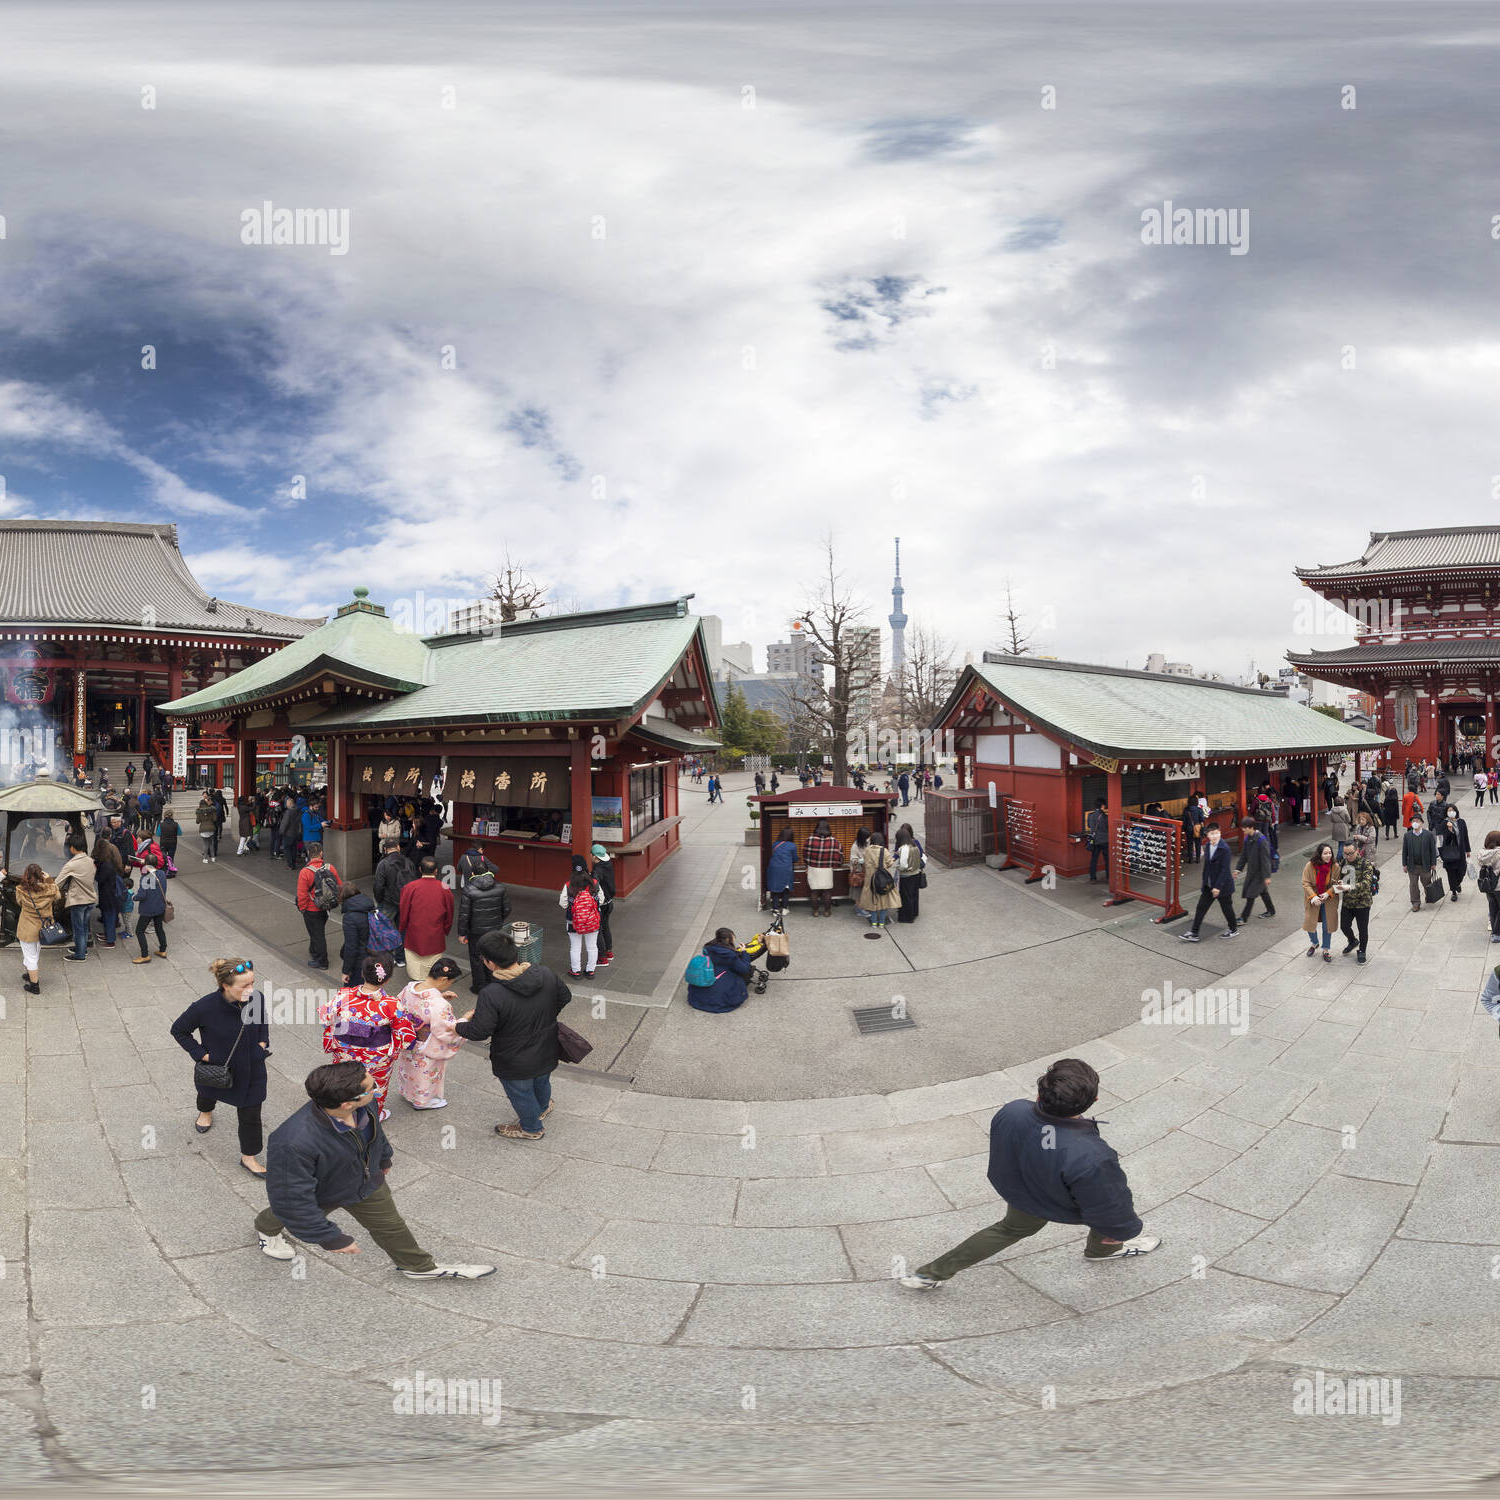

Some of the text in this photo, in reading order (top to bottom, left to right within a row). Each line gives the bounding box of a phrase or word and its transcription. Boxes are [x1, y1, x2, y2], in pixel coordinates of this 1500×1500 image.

[460, 769, 548, 794] 授香所
[795, 807, 834, 816] みくじ
